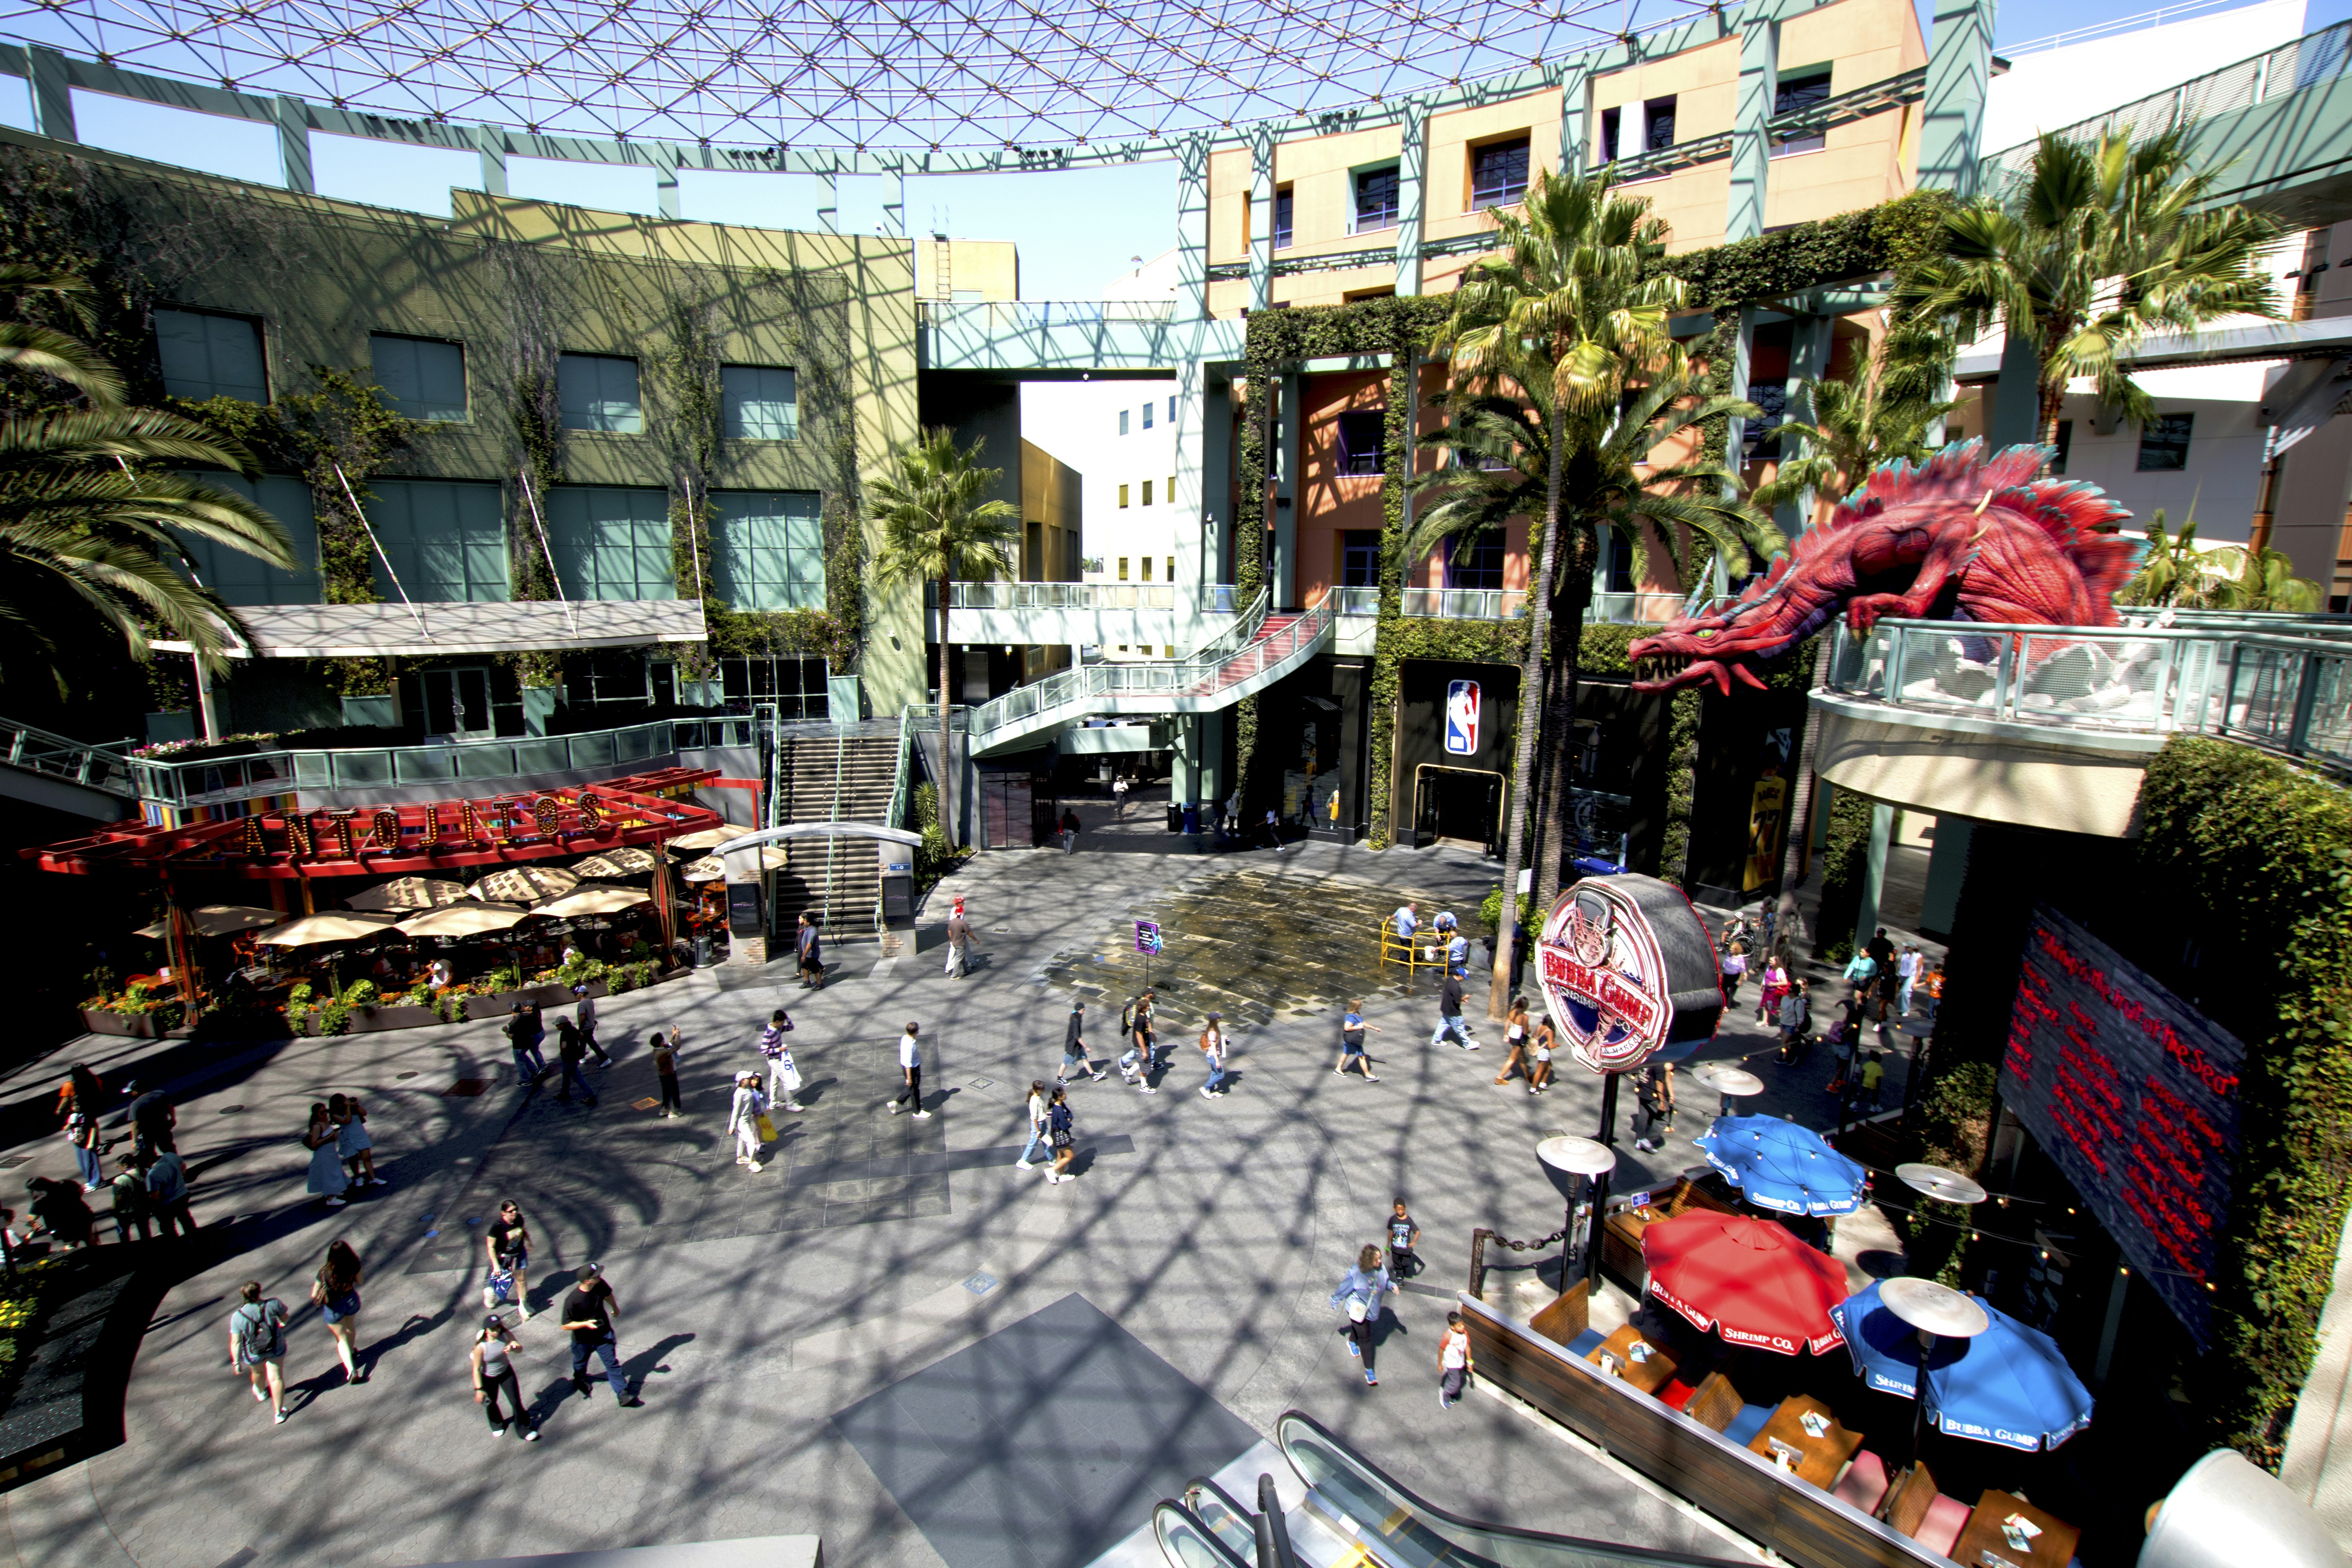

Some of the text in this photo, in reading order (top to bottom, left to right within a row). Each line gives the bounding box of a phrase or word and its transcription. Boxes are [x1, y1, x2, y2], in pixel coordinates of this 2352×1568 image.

[243, 791, 601, 856] ANTOJITOS
[1546, 951, 1597, 996] BUBBA
[1599, 974, 1654, 1030] GUMP
[1559, 985, 1598, 1010] SHRIMP
[2091, 969, 2110, 1001] the
[2113, 989, 2144, 1021] fruit
[2143, 1019, 2161, 1038] of
[2162, 1025, 2189, 1066] the
[784, 1060, 791, 1070] 6
[1752, 1192, 1786, 1209] SHRIMP
[1829, 1200, 1853, 1210] GUMP
[1684, 1305, 1709, 1328] GUMP
[1725, 1328, 1795, 1351] SHRIMP CO.
[1875, 1373, 1917, 1396] SHRIM
[1945, 1418, 1991, 1437] BUBBA
[1994, 1428, 2038, 1447] GUMP
